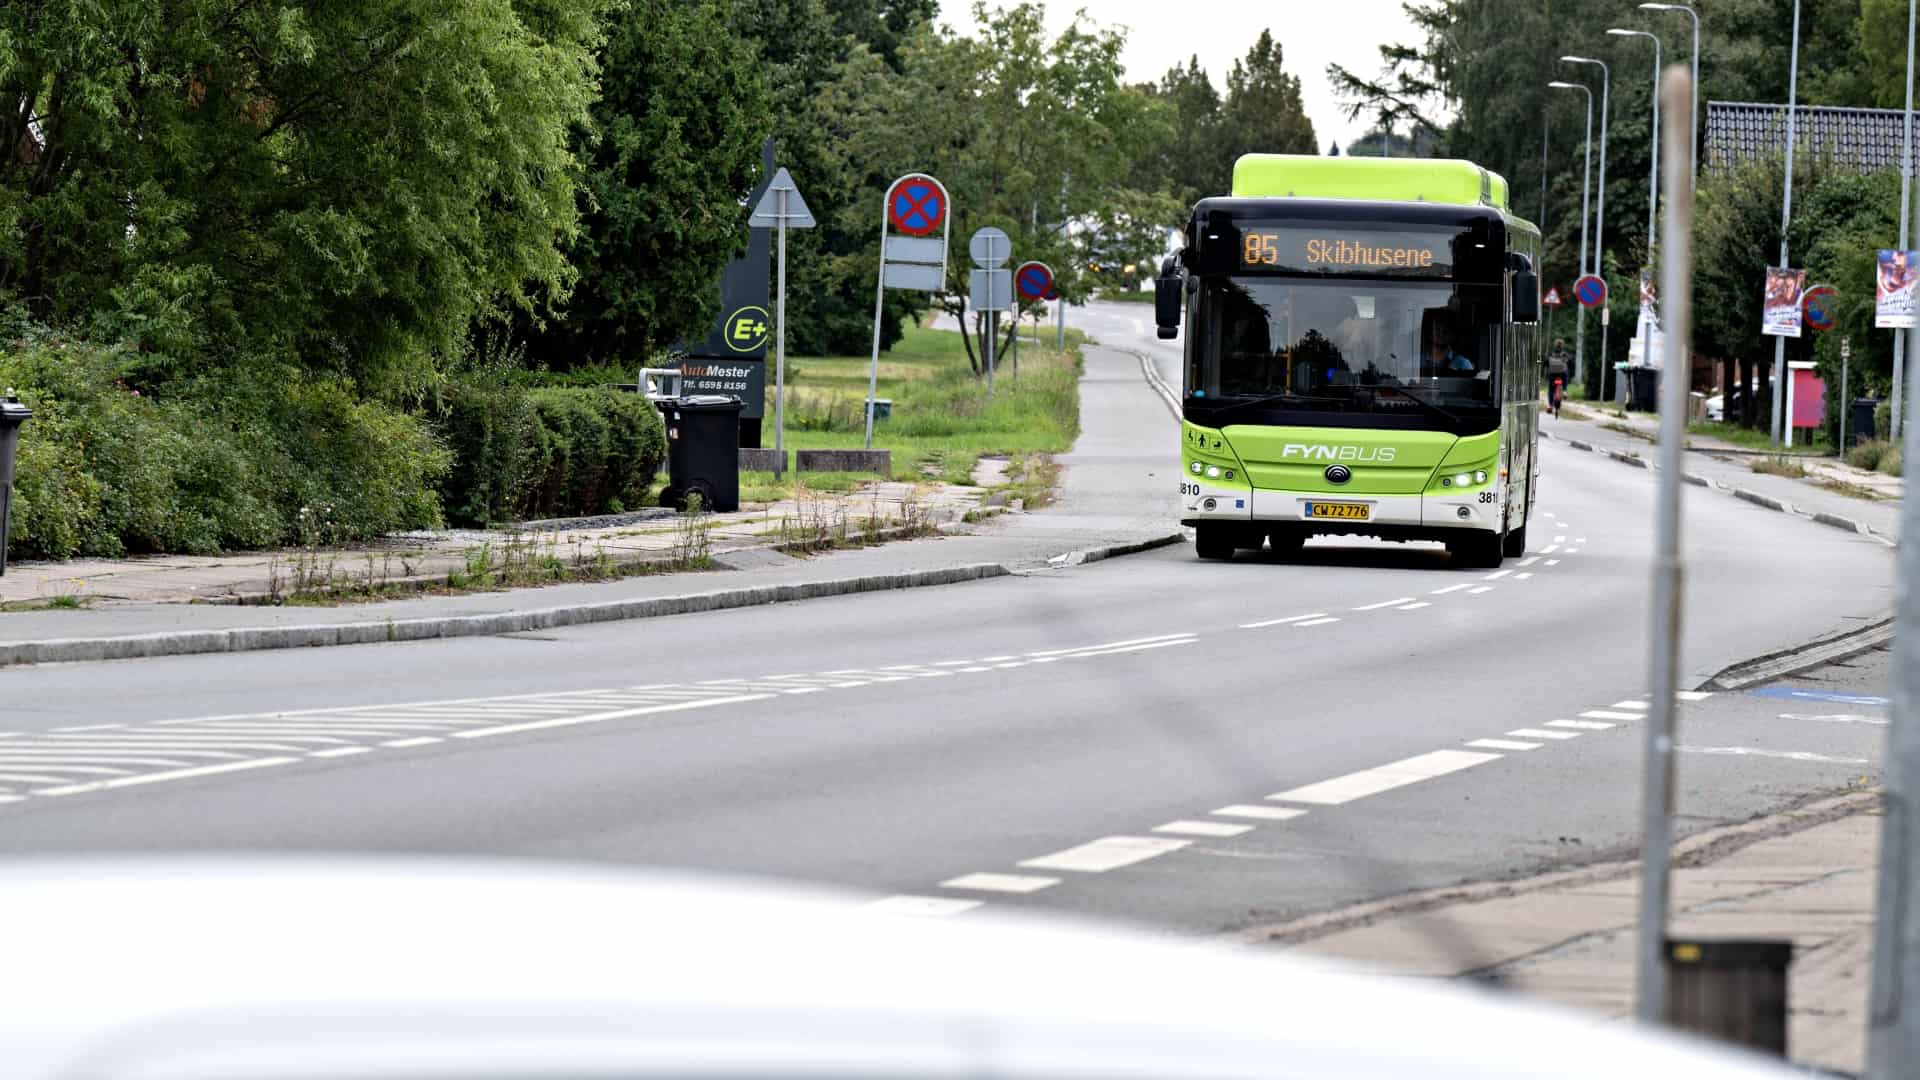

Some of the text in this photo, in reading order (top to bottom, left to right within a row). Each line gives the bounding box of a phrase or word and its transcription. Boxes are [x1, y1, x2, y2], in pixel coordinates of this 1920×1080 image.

[1244, 233, 1432, 267] 85 Skibhusene
[1281, 443, 1396, 462] FYNBUS
[1478, 491, 1499, 504] 381
[1313, 504, 1328, 516] CW
[1331, 505, 1345, 517] 72
[1347, 506, 1368, 518] 776
